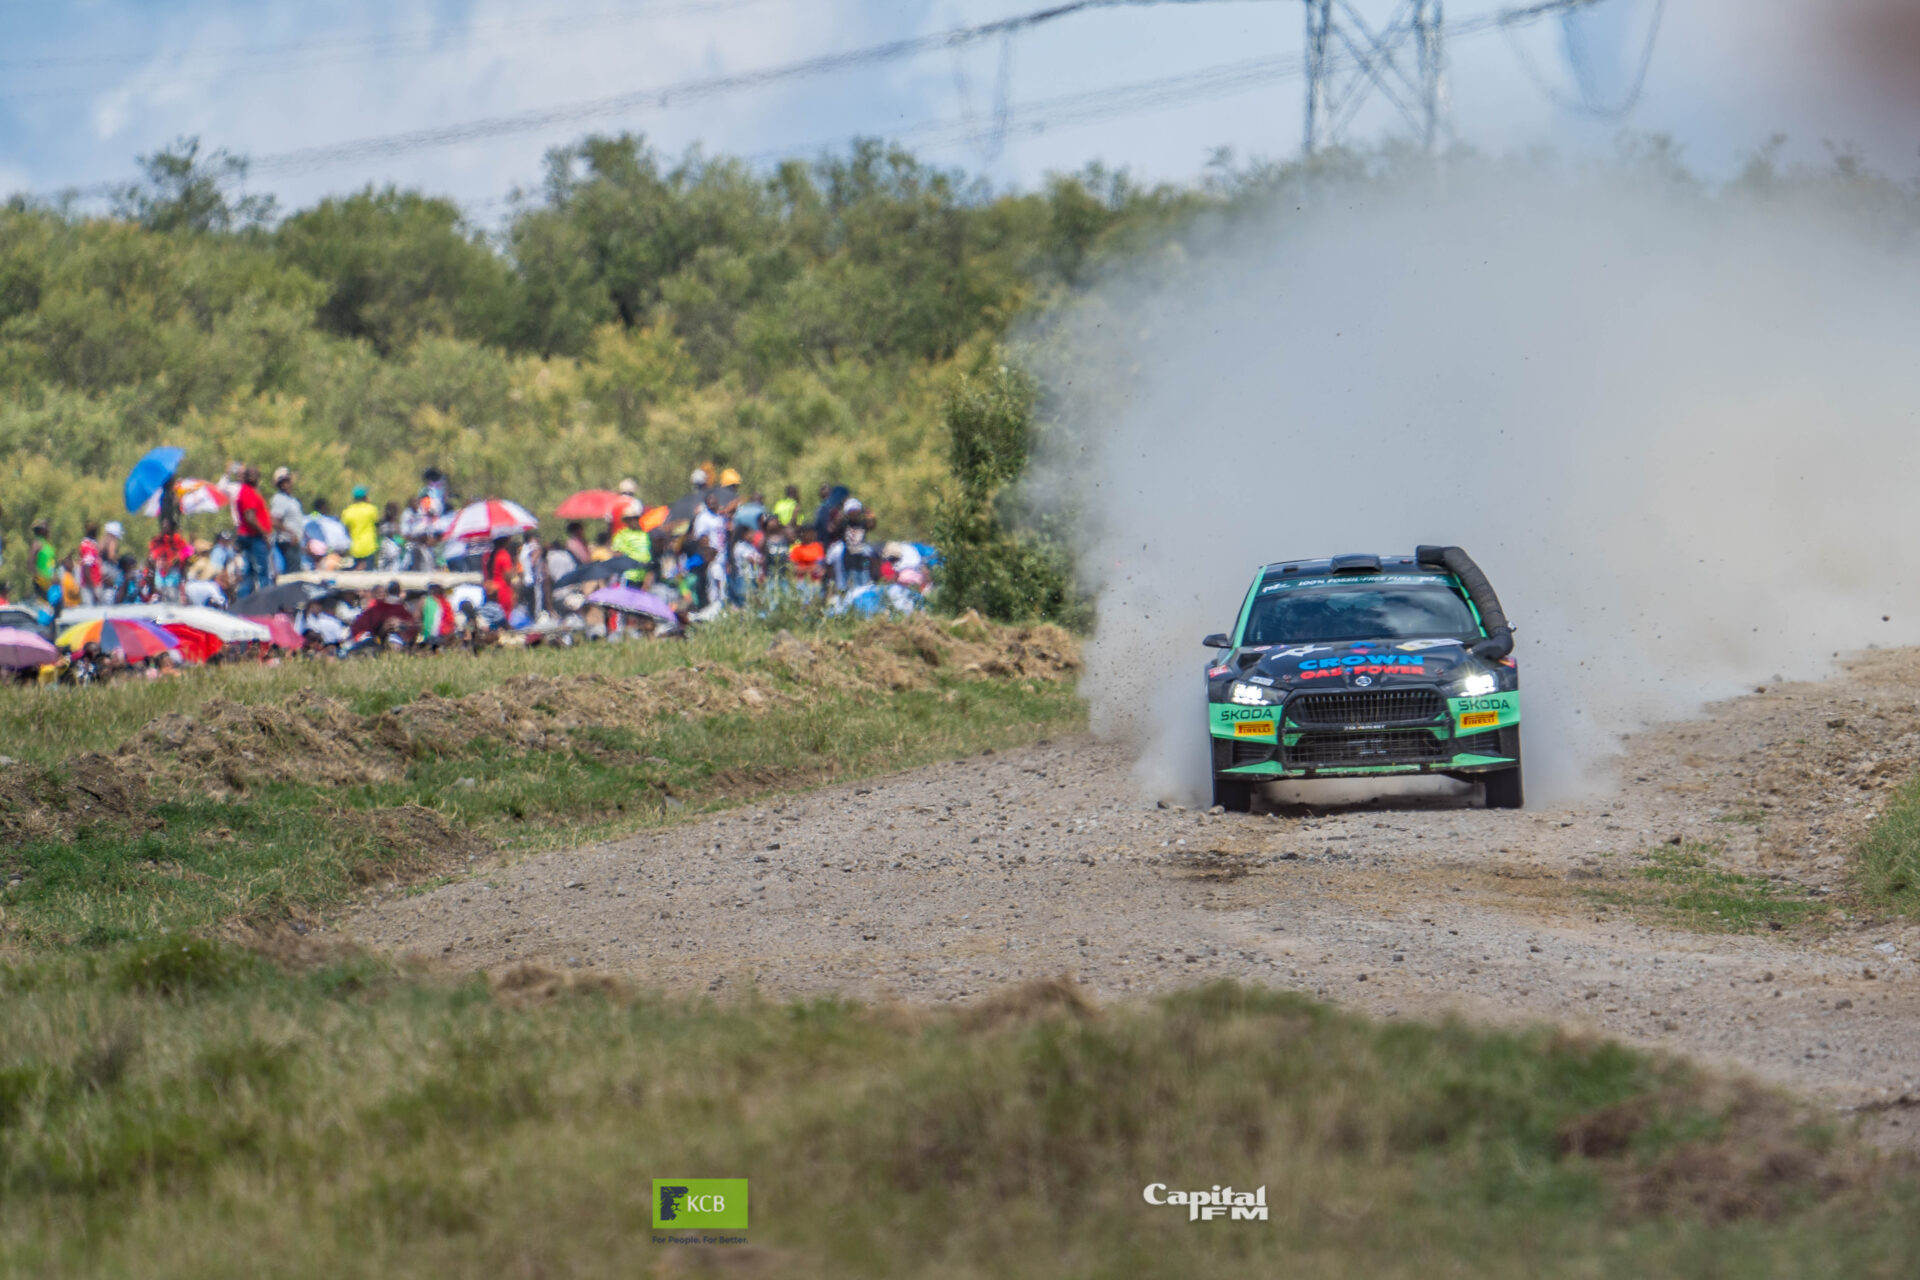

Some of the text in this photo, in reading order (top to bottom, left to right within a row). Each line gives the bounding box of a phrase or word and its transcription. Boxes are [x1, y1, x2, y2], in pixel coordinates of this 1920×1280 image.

[1298, 655, 1424, 670] CROWN
[1300, 665, 1425, 680] GAS POWER
[1463, 711, 1496, 726] PIRELLI
[1238, 723, 1271, 734] PIRELLI
